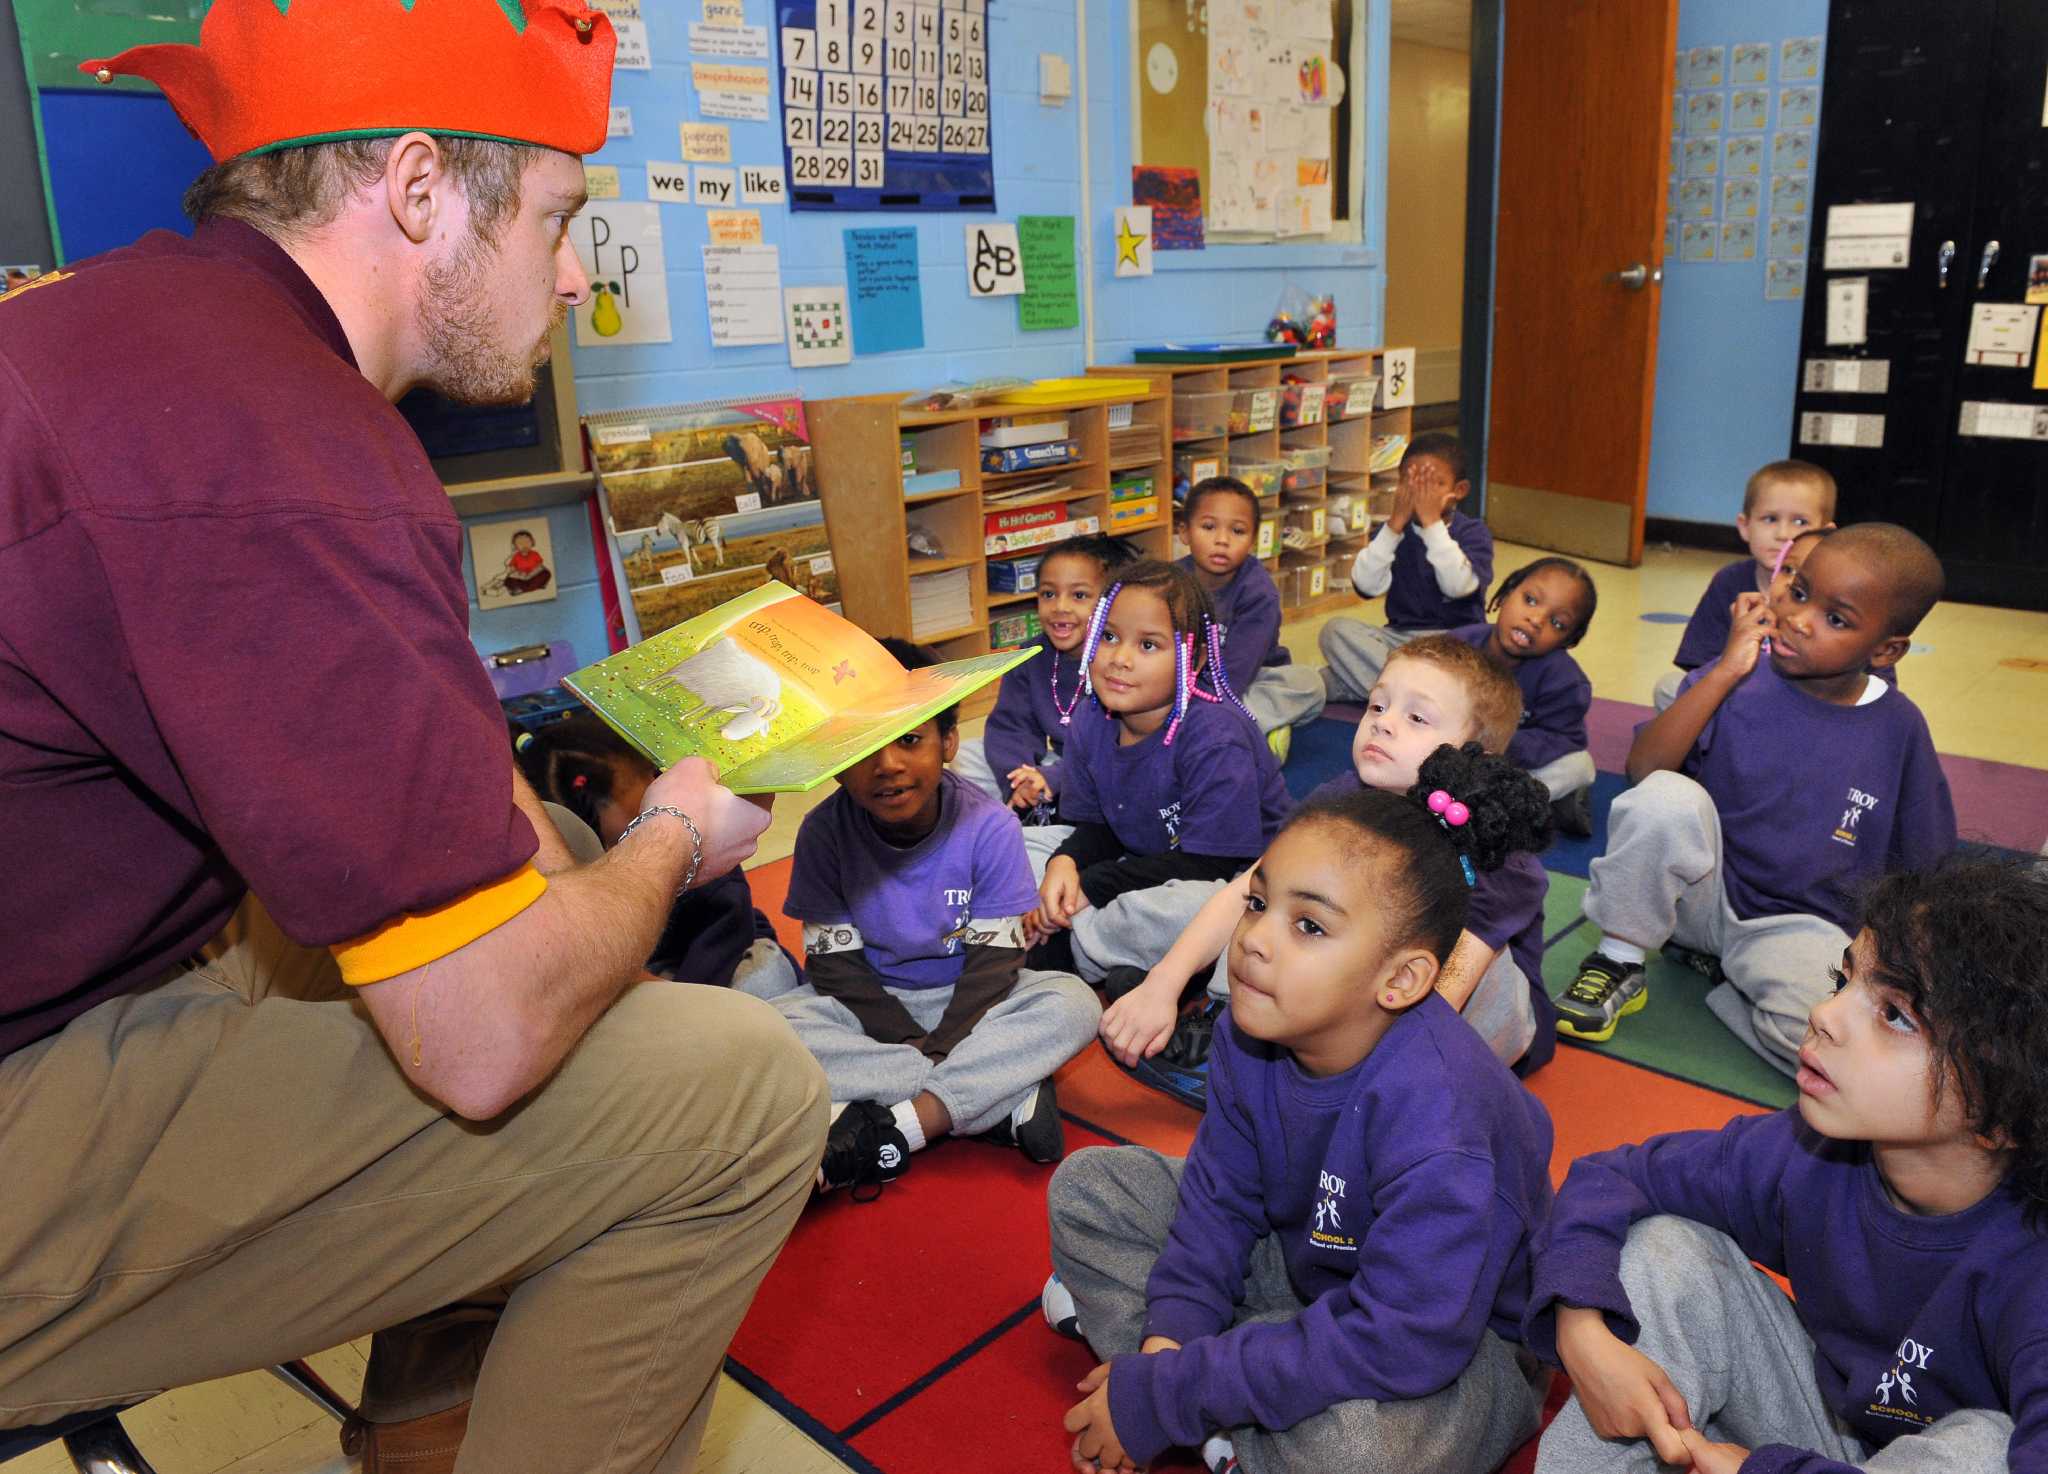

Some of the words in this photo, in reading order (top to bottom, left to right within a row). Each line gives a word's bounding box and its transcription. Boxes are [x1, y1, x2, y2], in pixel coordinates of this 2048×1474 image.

[829, 3, 836, 27] 1
[863, 8, 876, 30] 2
[894, 11, 905, 33] 3
[921, 14, 932, 37] 4
[950, 19, 960, 40] 5
[971, 21, 979, 41] 6
[793, 38, 805, 61] 7
[827, 41, 840, 64] 8
[862, 43, 874, 65] 9
[891, 48, 910, 71] 10
[921, 51, 935, 73] 11
[947, 53, 962, 75] 12
[969, 57, 982, 79] 13
[791, 77, 812, 101] 14
[828, 81, 849, 105] 15
[859, 83, 878, 106] 16
[891, 85, 909, 108] 17
[919, 87, 935, 109] 18
[945, 88, 961, 110] 19
[968, 92, 986, 113] 20
[791, 117, 813, 141] 21
[824, 119, 849, 142] 22
[858, 122, 881, 144] 23
[891, 122, 912, 144] 24
[917, 124, 937, 146] 25
[945, 125, 963, 147] 26
[967, 127, 985, 147] 27
[794, 156, 820, 178] 28
[825, 157, 849, 179] 29
[861, 159, 878, 181] 31
[653, 176, 685, 191] we
[700, 181, 730, 201] my
[744, 172, 781, 193] like
[591, 216, 610, 275] P
[1158, 801, 1181, 819] ROY
[1847, 787, 1879, 810] TROY
[944, 888, 972, 906] TR
[1320, 1169, 1346, 1198] ROY
[1896, 1337, 1934, 1370] OY
